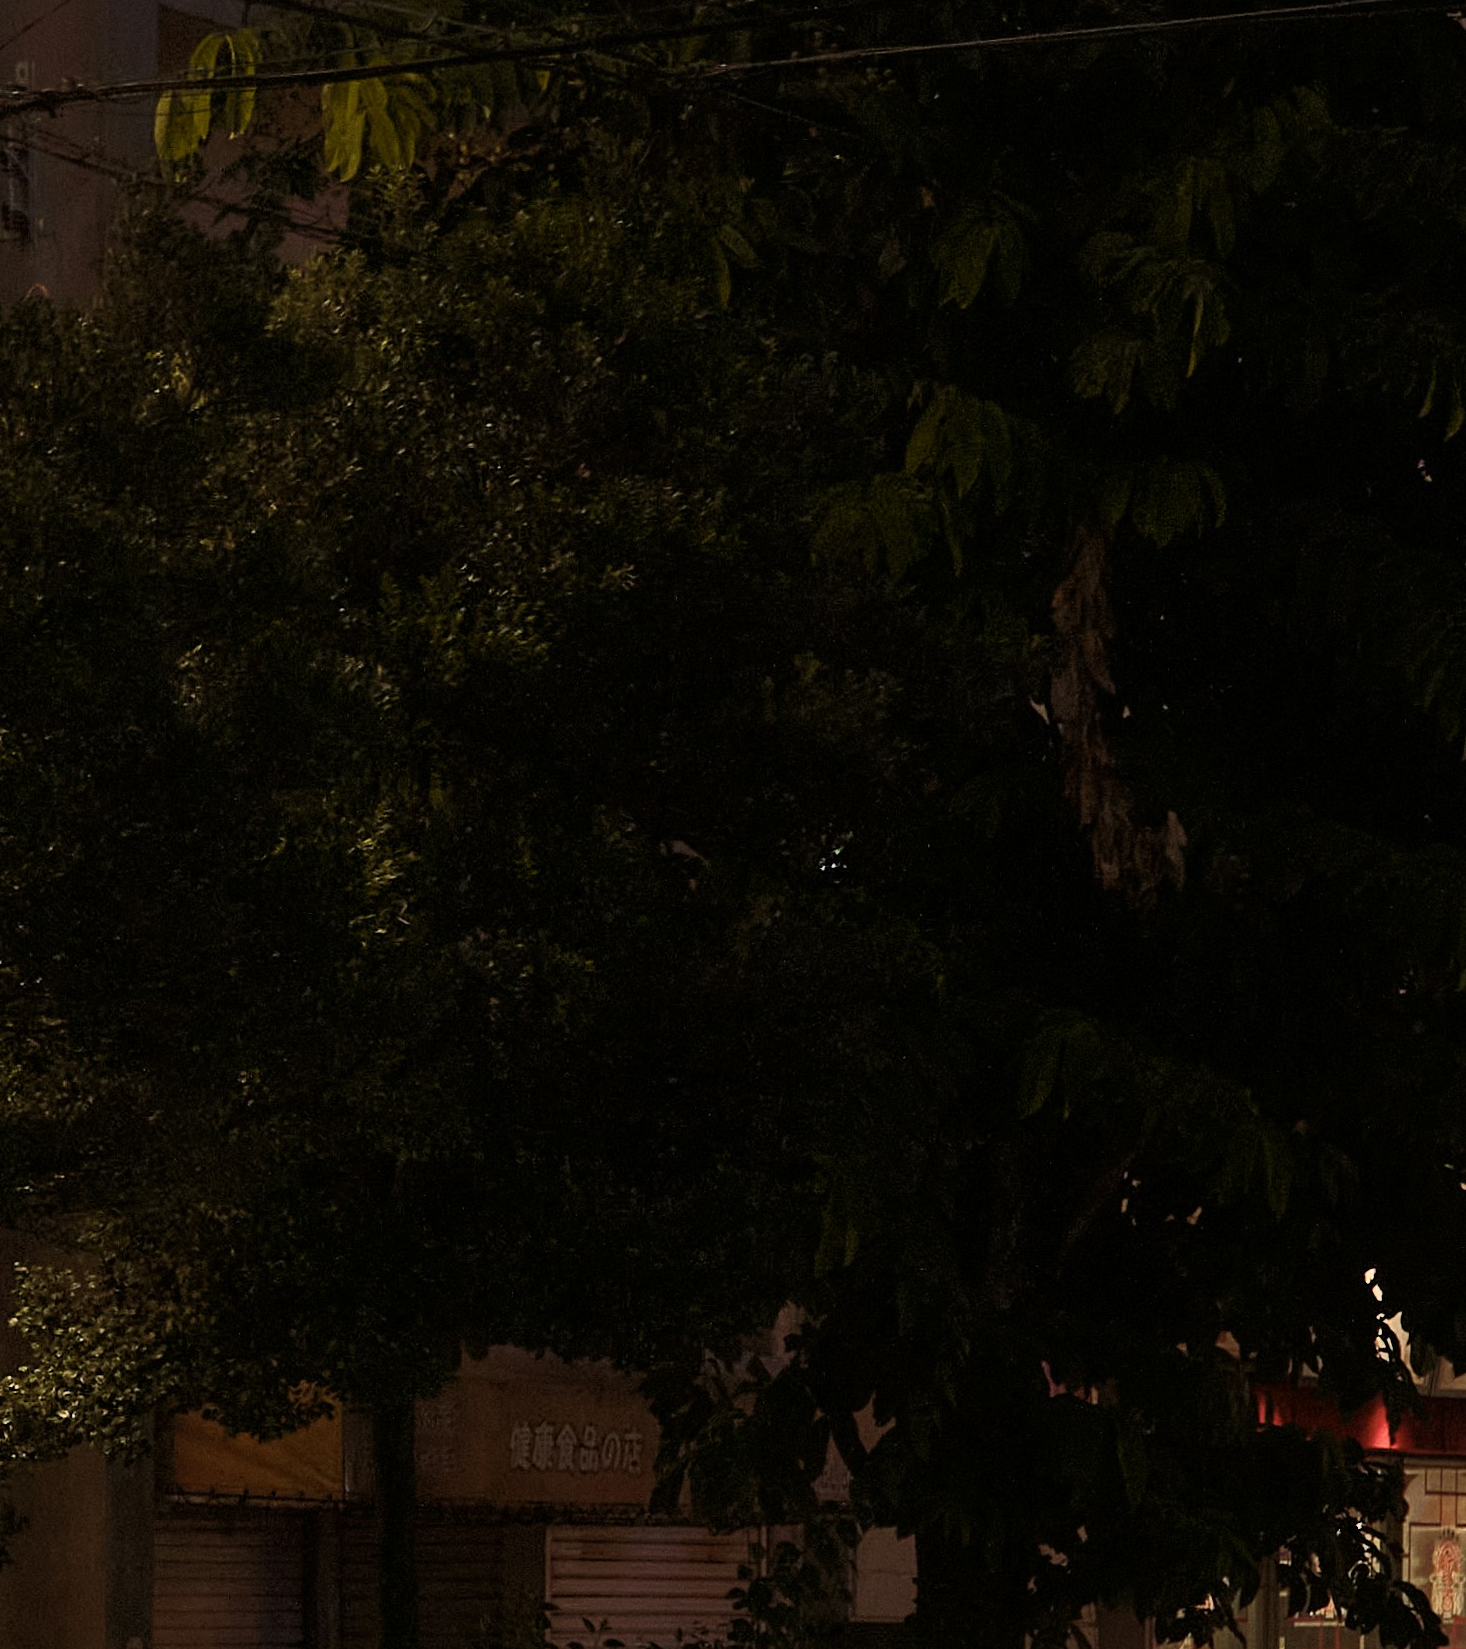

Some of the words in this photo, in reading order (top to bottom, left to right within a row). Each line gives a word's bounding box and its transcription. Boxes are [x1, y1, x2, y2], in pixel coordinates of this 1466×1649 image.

[510, 1419, 644, 1474] 健康食品の店
